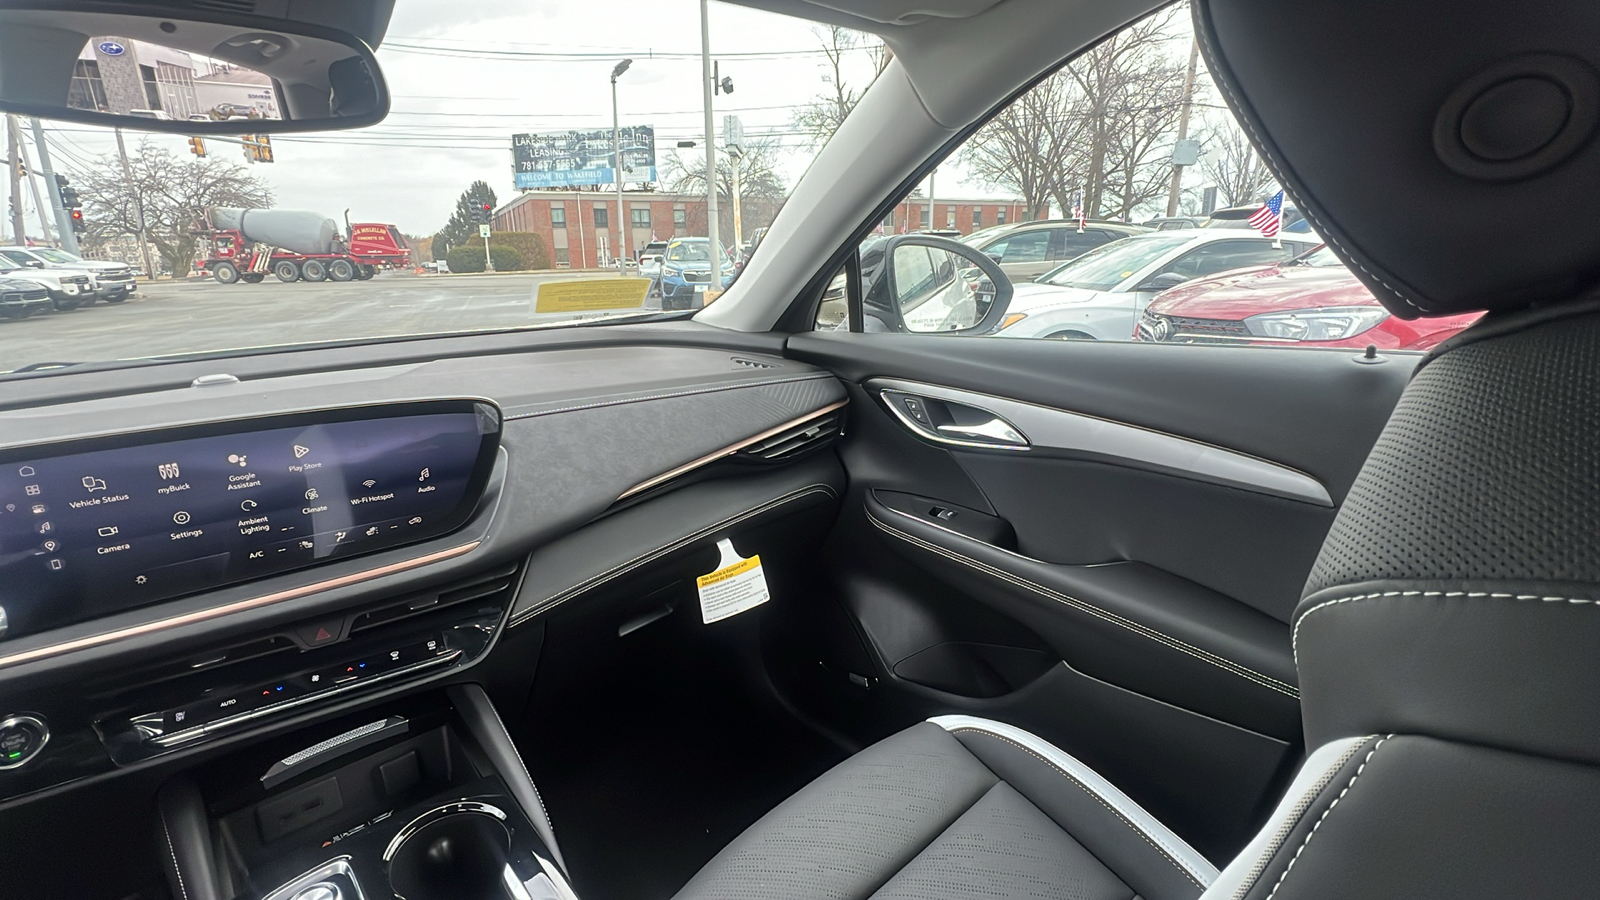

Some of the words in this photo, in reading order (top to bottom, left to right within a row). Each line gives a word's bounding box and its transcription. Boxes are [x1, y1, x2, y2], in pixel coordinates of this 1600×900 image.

[585, 131, 629, 149] Lakesde
[631, 129, 649, 144] Inn
[530, 147, 565, 158] LEASING
[521, 172, 551, 182] WELCOME
[555, 172, 565, 180] TO
[567, 170, 602, 179] WAKEFIELD
[288, 465, 303, 474] Play
[304, 462, 322, 471] Store
[229, 473, 256, 485] Google
[157, 483, 191, 495] myBuick
[227, 480, 261, 491] Assistant
[417, 485, 436, 494] Audio
[69, 498, 101, 509] Vehicle
[102, 493, 130, 504] Status
[351, 496, 368, 506] Wi-Fi
[368, 492, 395, 503] Hotspot
[302, 504, 328, 515] Climate
[238, 515, 268, 527] Ambient
[170, 528, 203, 540] Settings
[240, 524, 271, 536] Lighting
[97, 543, 131, 555] Camera
[249, 550, 265, 559] A/C
[220, 698, 237, 708] AUTO
